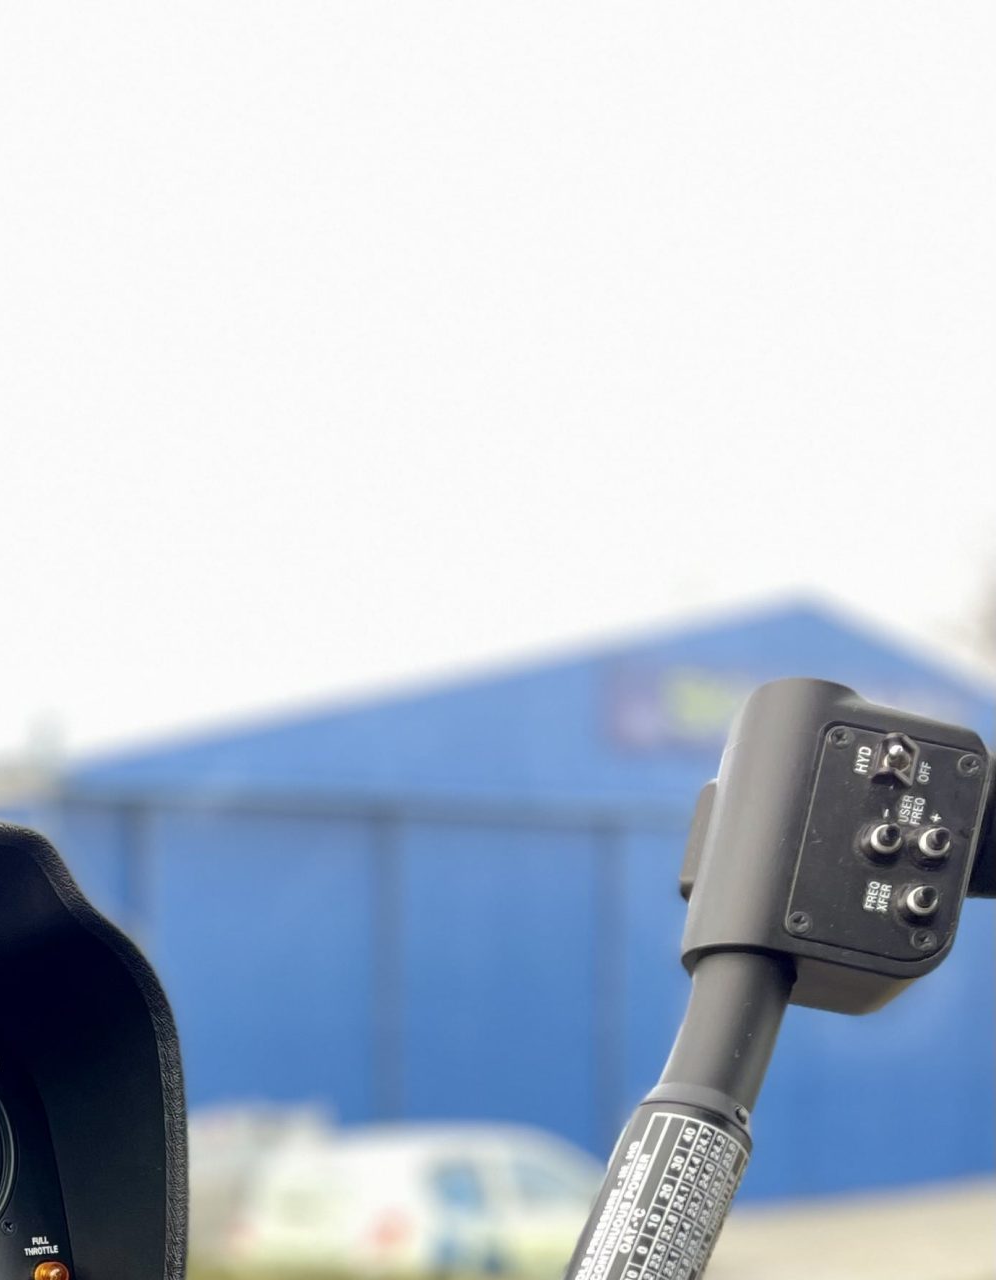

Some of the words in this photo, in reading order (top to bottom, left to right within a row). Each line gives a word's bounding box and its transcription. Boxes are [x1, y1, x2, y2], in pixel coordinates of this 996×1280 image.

[855, 746, 872, 773] HYD
[917, 762, 931, 784] OFF
[899, 795, 913, 823] USER
[910, 798, 925, 825] FREQ
[864, 881, 880, 910] FREQ
[876, 884, 892, 912] XFER
[624, 1154, 652, 1200] POWER
[647, 1214, 661, 1228] 10
[683, 1127, 696, 1142] 40
[24, 1245, 58, 1256] THROTTLE
[32, 1236, 49, 1245] FULL
